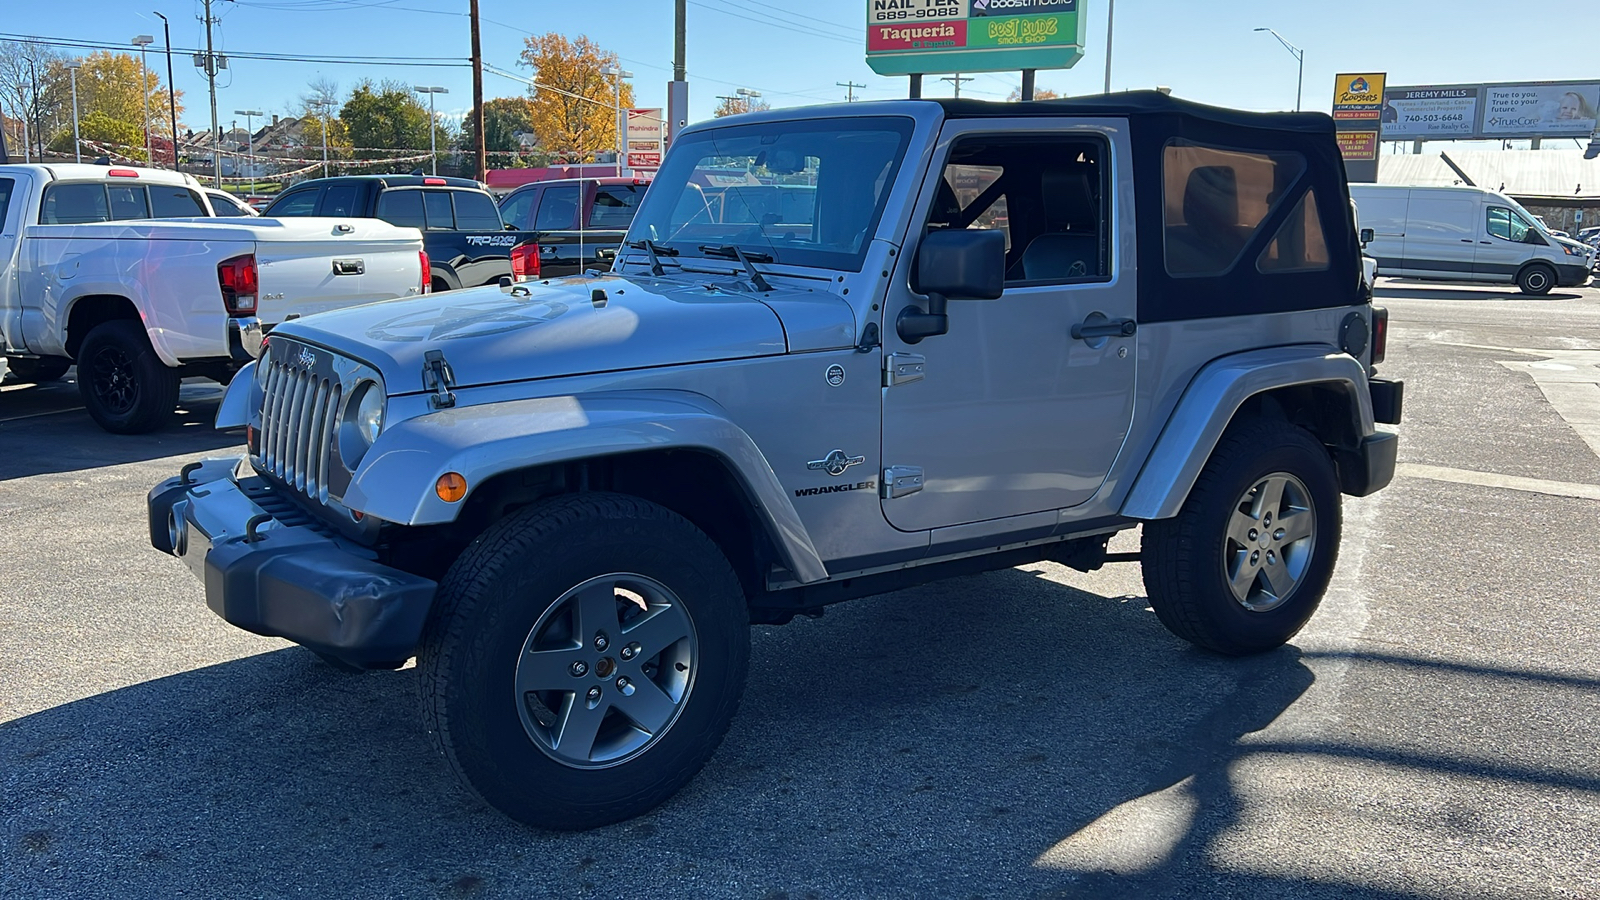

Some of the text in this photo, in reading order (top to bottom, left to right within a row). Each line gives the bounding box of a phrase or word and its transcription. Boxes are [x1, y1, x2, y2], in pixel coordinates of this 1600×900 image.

[875, 0, 915, 10] NAIL
[877, 8, 958, 20] 689-9088
[1021, 17, 1058, 37] BUDZ
[998, 37, 1023, 45] SMOKE
[1339, 92, 1378, 103] Roosters
[1405, 114, 1463, 122] 740-503-6648
[1498, 116, 1539, 125] TrueCore
[795, 481, 876, 497] WRANGLER
